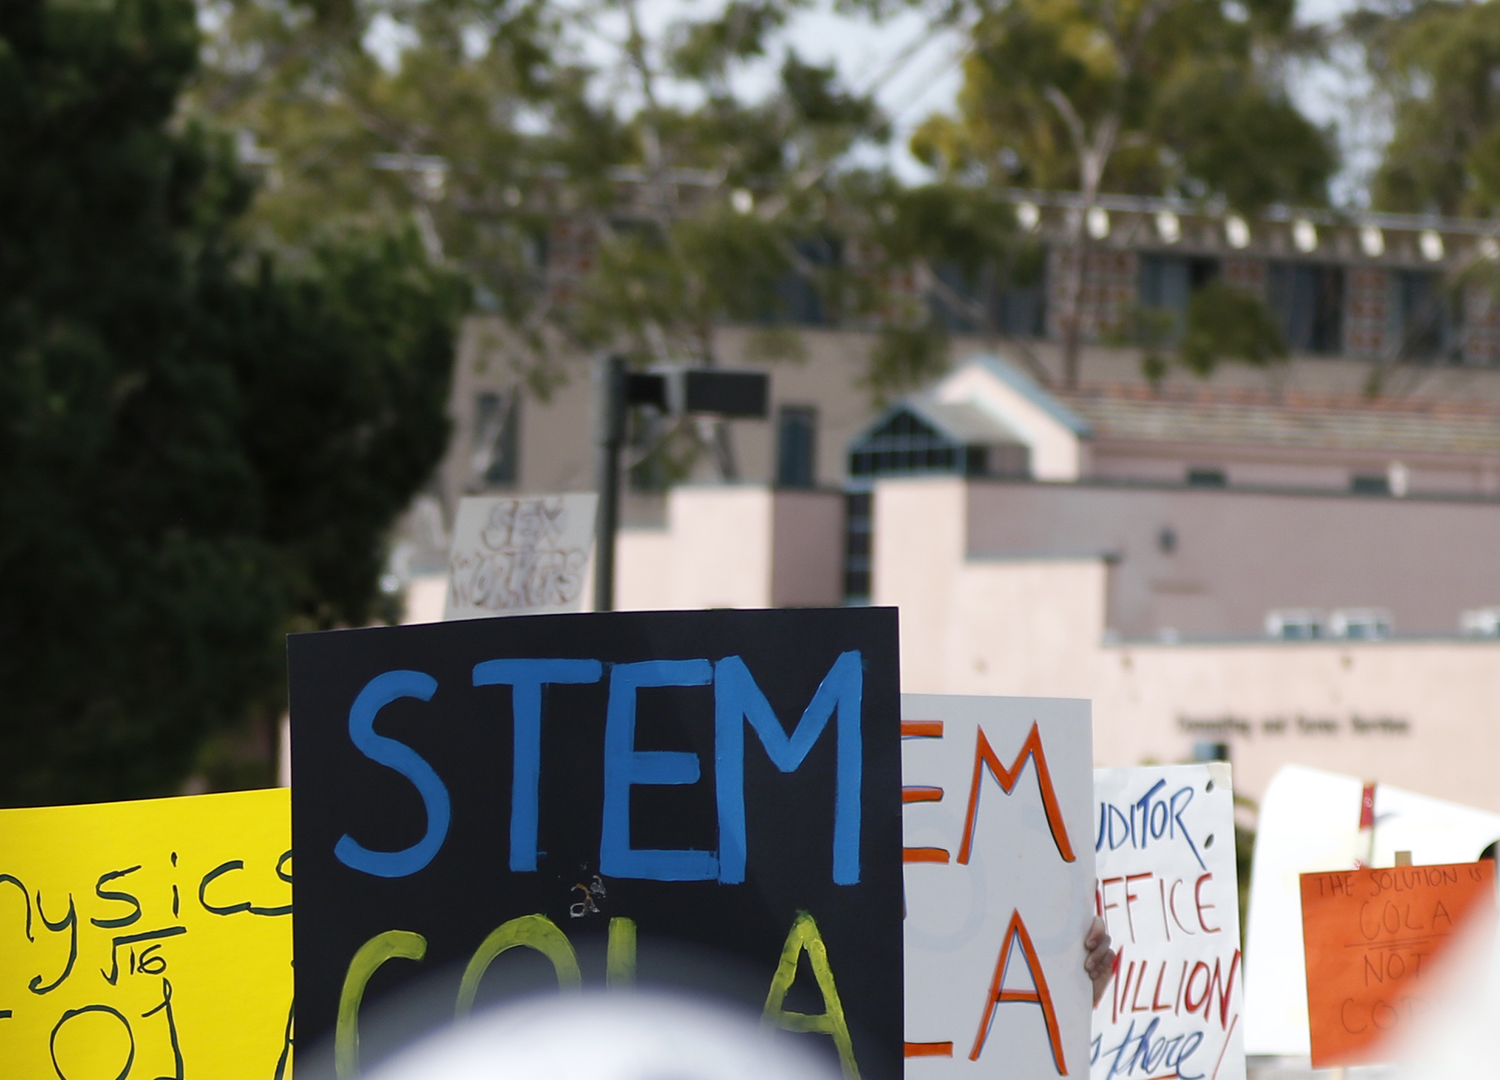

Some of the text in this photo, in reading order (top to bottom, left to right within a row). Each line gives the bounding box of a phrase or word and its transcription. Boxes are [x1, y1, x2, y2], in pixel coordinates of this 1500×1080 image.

[334, 650, 864, 886] STEM
[1315, 874, 1355, 898] THE
[1369, 866, 1458, 897] SOLUTION
[1095, 871, 1222, 944] FFICE
[1359, 899, 1453, 941] COLA
[1363, 951, 1431, 988] NOT
